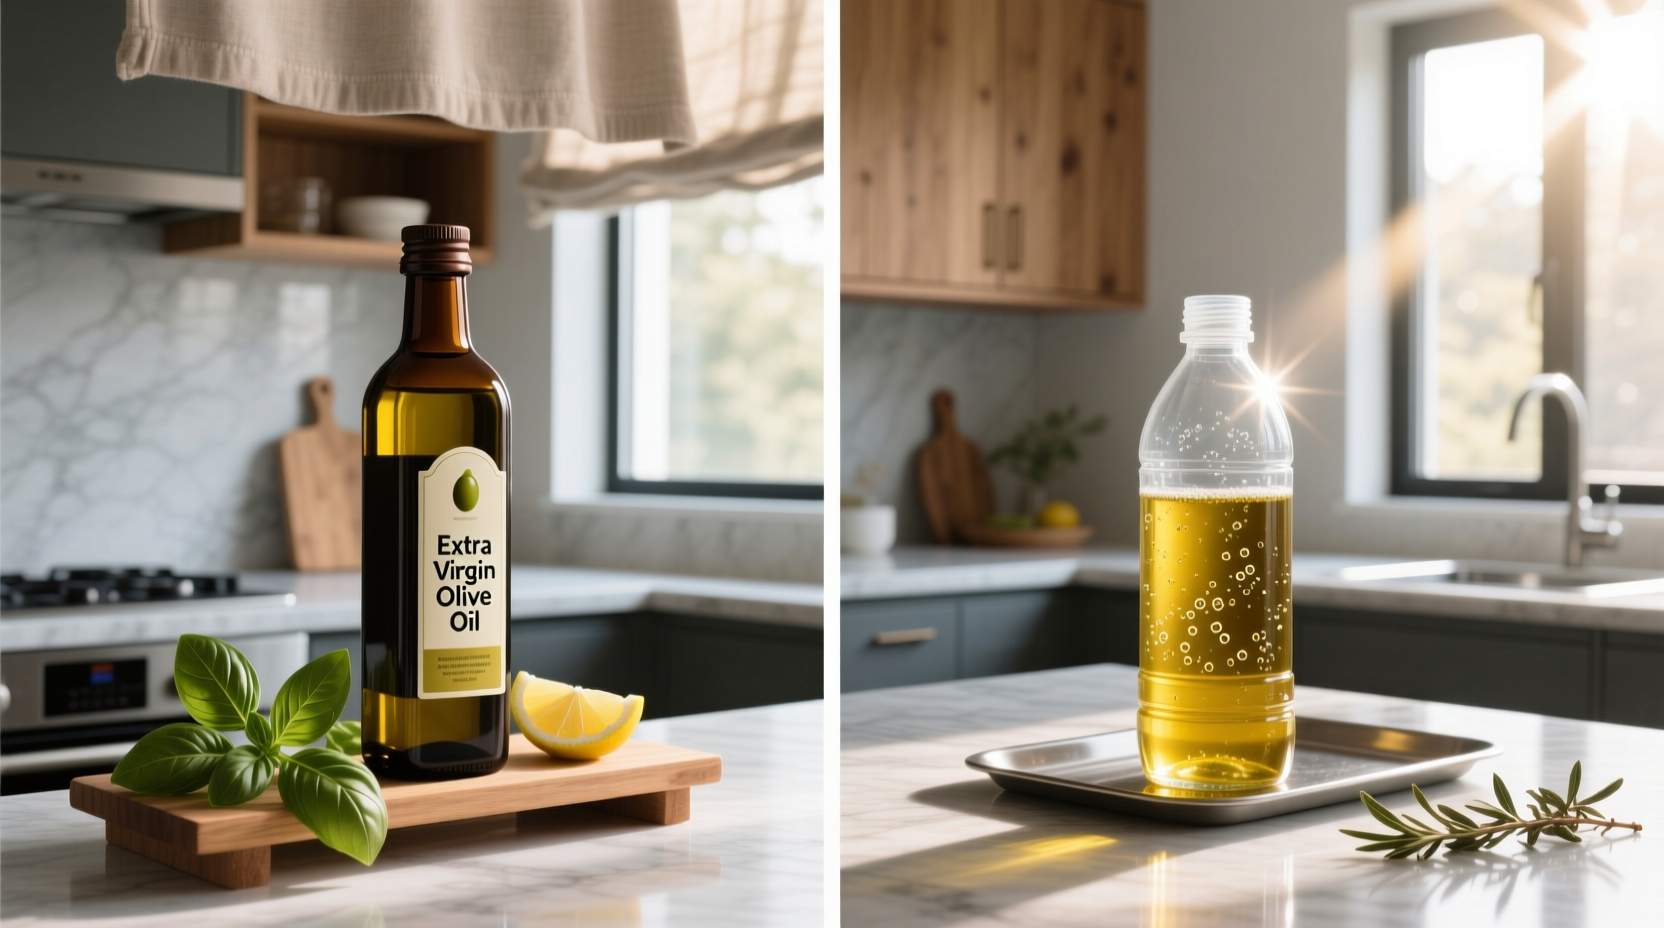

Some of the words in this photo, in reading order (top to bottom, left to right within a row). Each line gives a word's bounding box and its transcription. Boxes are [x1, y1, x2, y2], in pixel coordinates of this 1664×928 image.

[437, 534, 492, 556] Extra
[432, 559, 496, 585] Virgin
[436, 585, 492, 607] Olive
[450, 610, 480, 632] Oil
